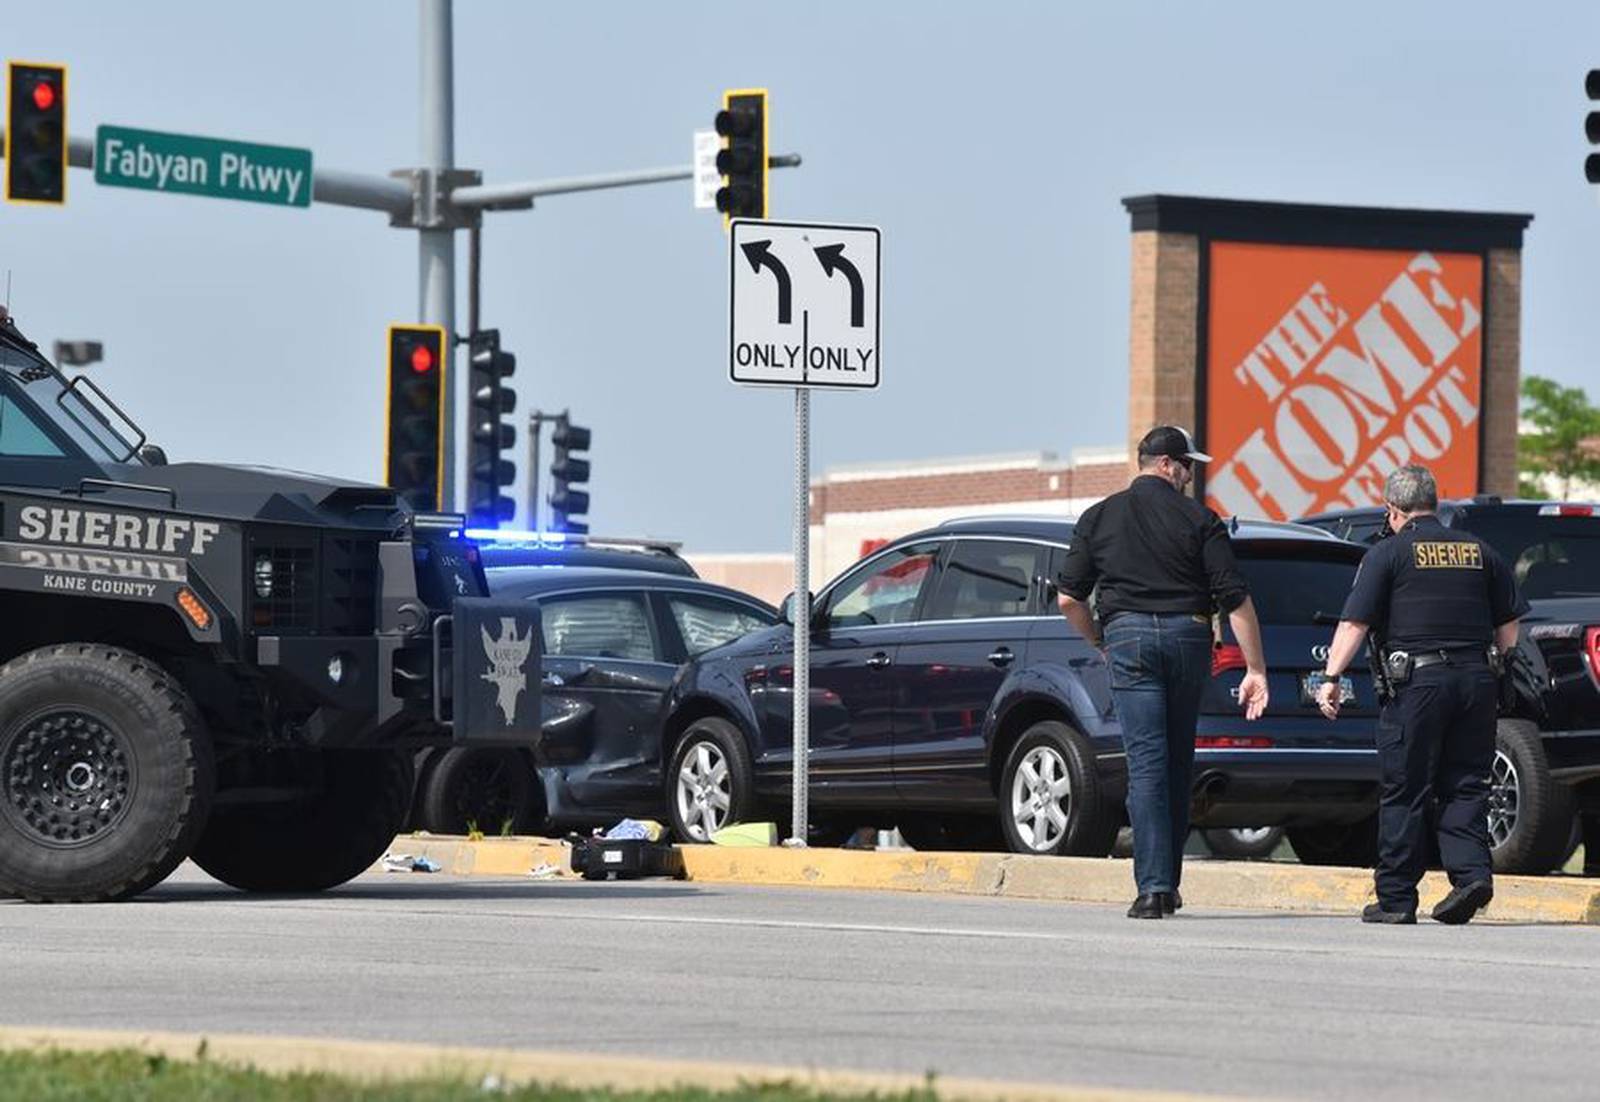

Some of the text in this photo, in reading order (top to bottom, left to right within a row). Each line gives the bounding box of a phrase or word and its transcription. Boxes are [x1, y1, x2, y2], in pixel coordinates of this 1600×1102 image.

[104, 139, 303, 203] Fabyan Pkwy
[736, 342, 873, 372] ONLY ONLY
[1233, 280, 1350, 404] THE
[1205, 252, 1481, 521] HOME
[1323, 365, 1479, 512] EPOT
[19, 506, 219, 554] SHERIFF
[1417, 543, 1479, 565] SHERIFF
[43, 574, 157, 597] KANE COUNTY
